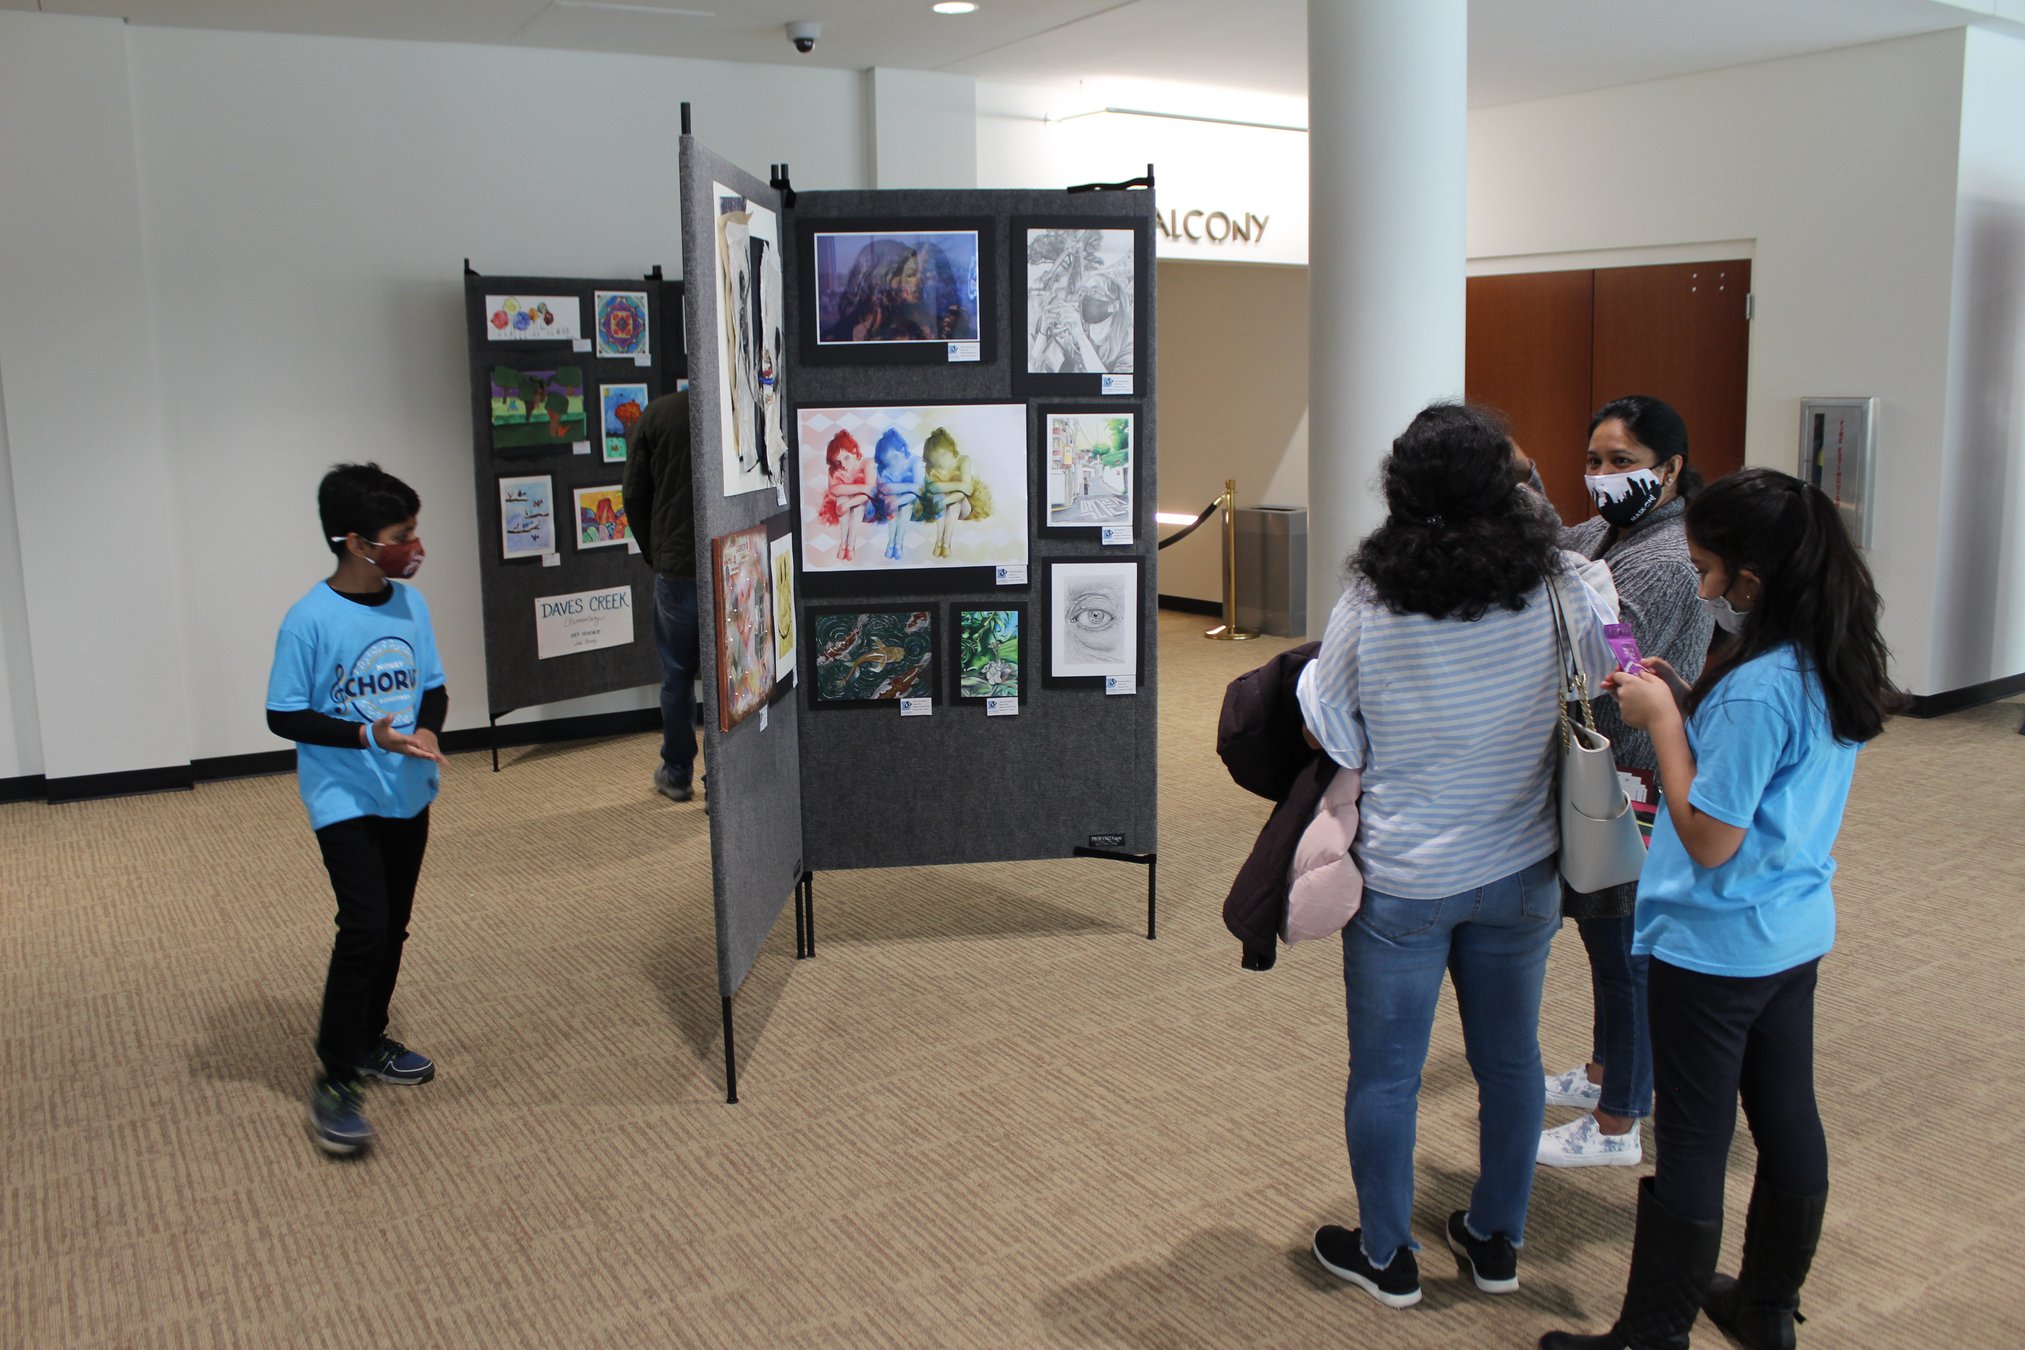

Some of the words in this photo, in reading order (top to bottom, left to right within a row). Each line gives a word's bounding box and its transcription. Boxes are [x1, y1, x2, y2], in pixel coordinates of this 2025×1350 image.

[1156, 208, 1270, 243] ALCONY
[541, 598, 584, 619] DAVES
[589, 592, 630, 612] CREEK
[345, 668, 417, 698] CHORU
